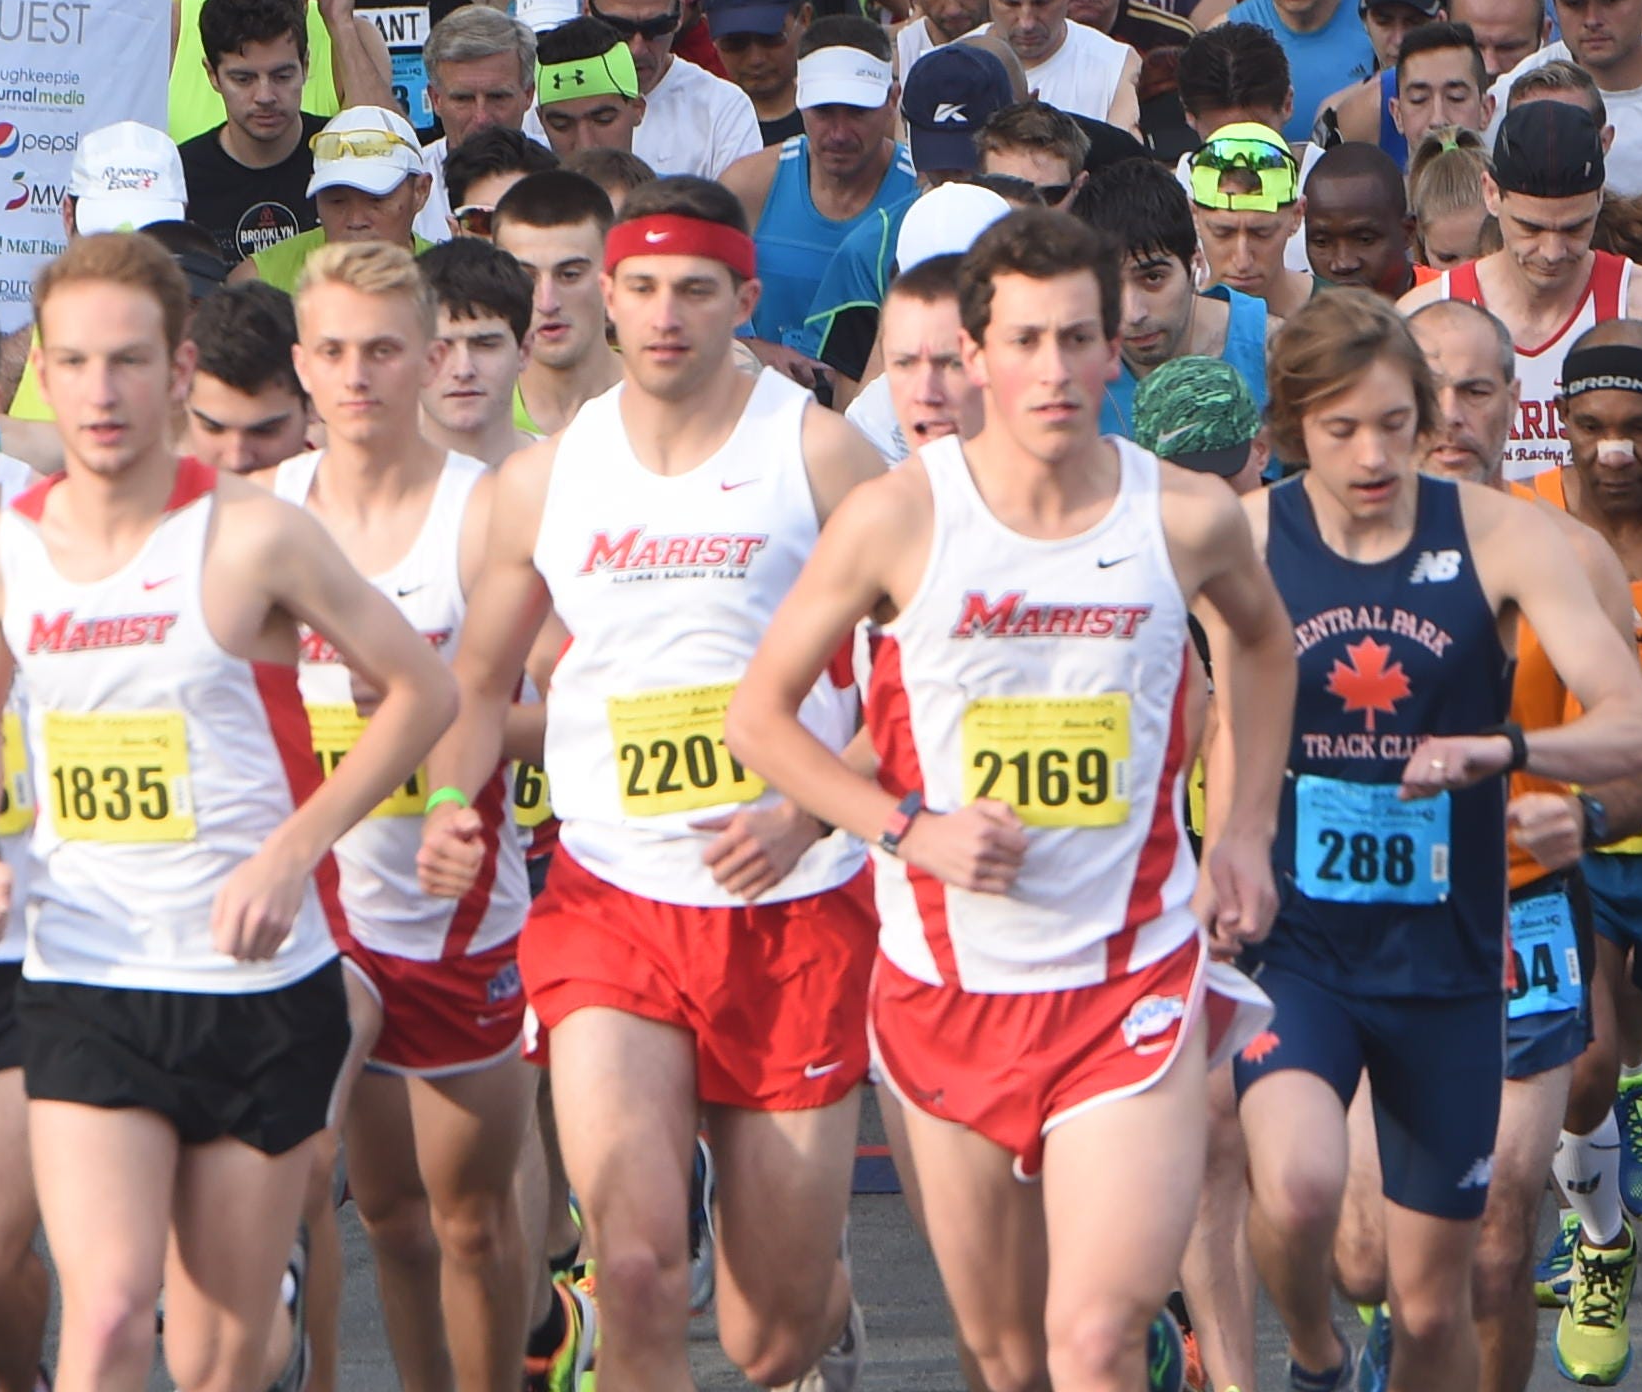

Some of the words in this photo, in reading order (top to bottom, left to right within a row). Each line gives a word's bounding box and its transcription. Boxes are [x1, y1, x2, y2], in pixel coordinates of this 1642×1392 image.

[240, 225, 295, 244] BROOKLYN
[575, 524, 770, 577] MARIST
[25, 609, 181, 656] MARIST
[948, 589, 1155, 639] MARIST
[1389, 606, 1455, 659] PARK
[1302, 733, 1377, 760] TRACK
[1379, 733, 1429, 760] CLU
[53, 765, 169, 822] 1835
[973, 747, 1109, 806] 2169
[1316, 827, 1417, 887] 288
